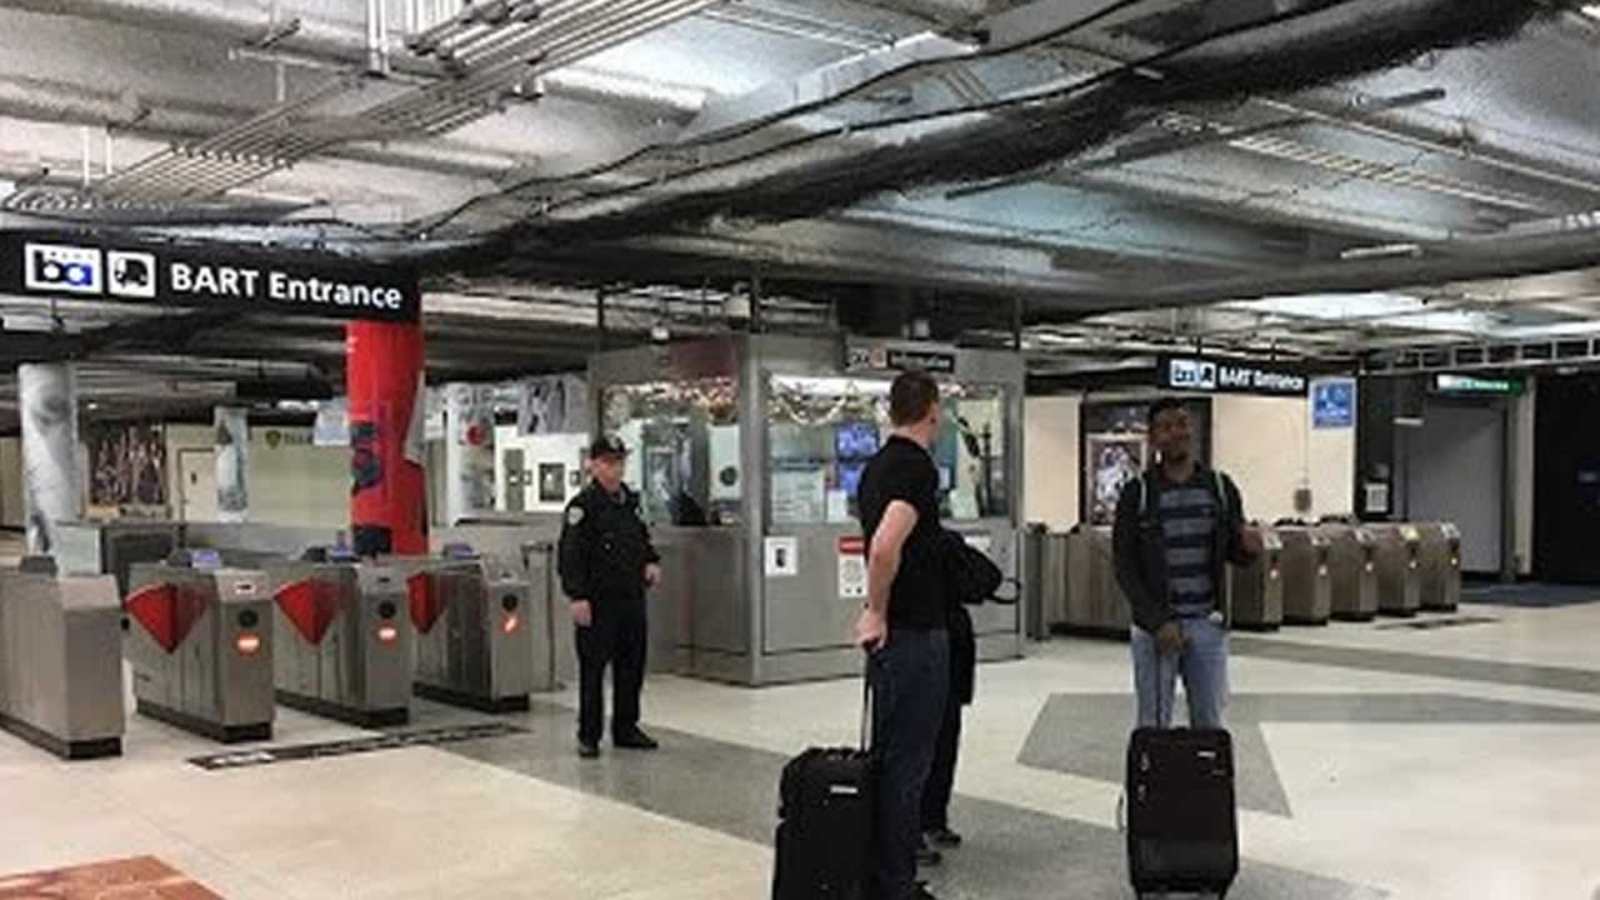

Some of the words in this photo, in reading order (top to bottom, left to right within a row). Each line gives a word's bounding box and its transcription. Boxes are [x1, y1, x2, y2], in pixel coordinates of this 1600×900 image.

[171, 262, 259, 297] BART
[269, 270, 402, 309] Entrance
[1219, 366, 1253, 387] BART
